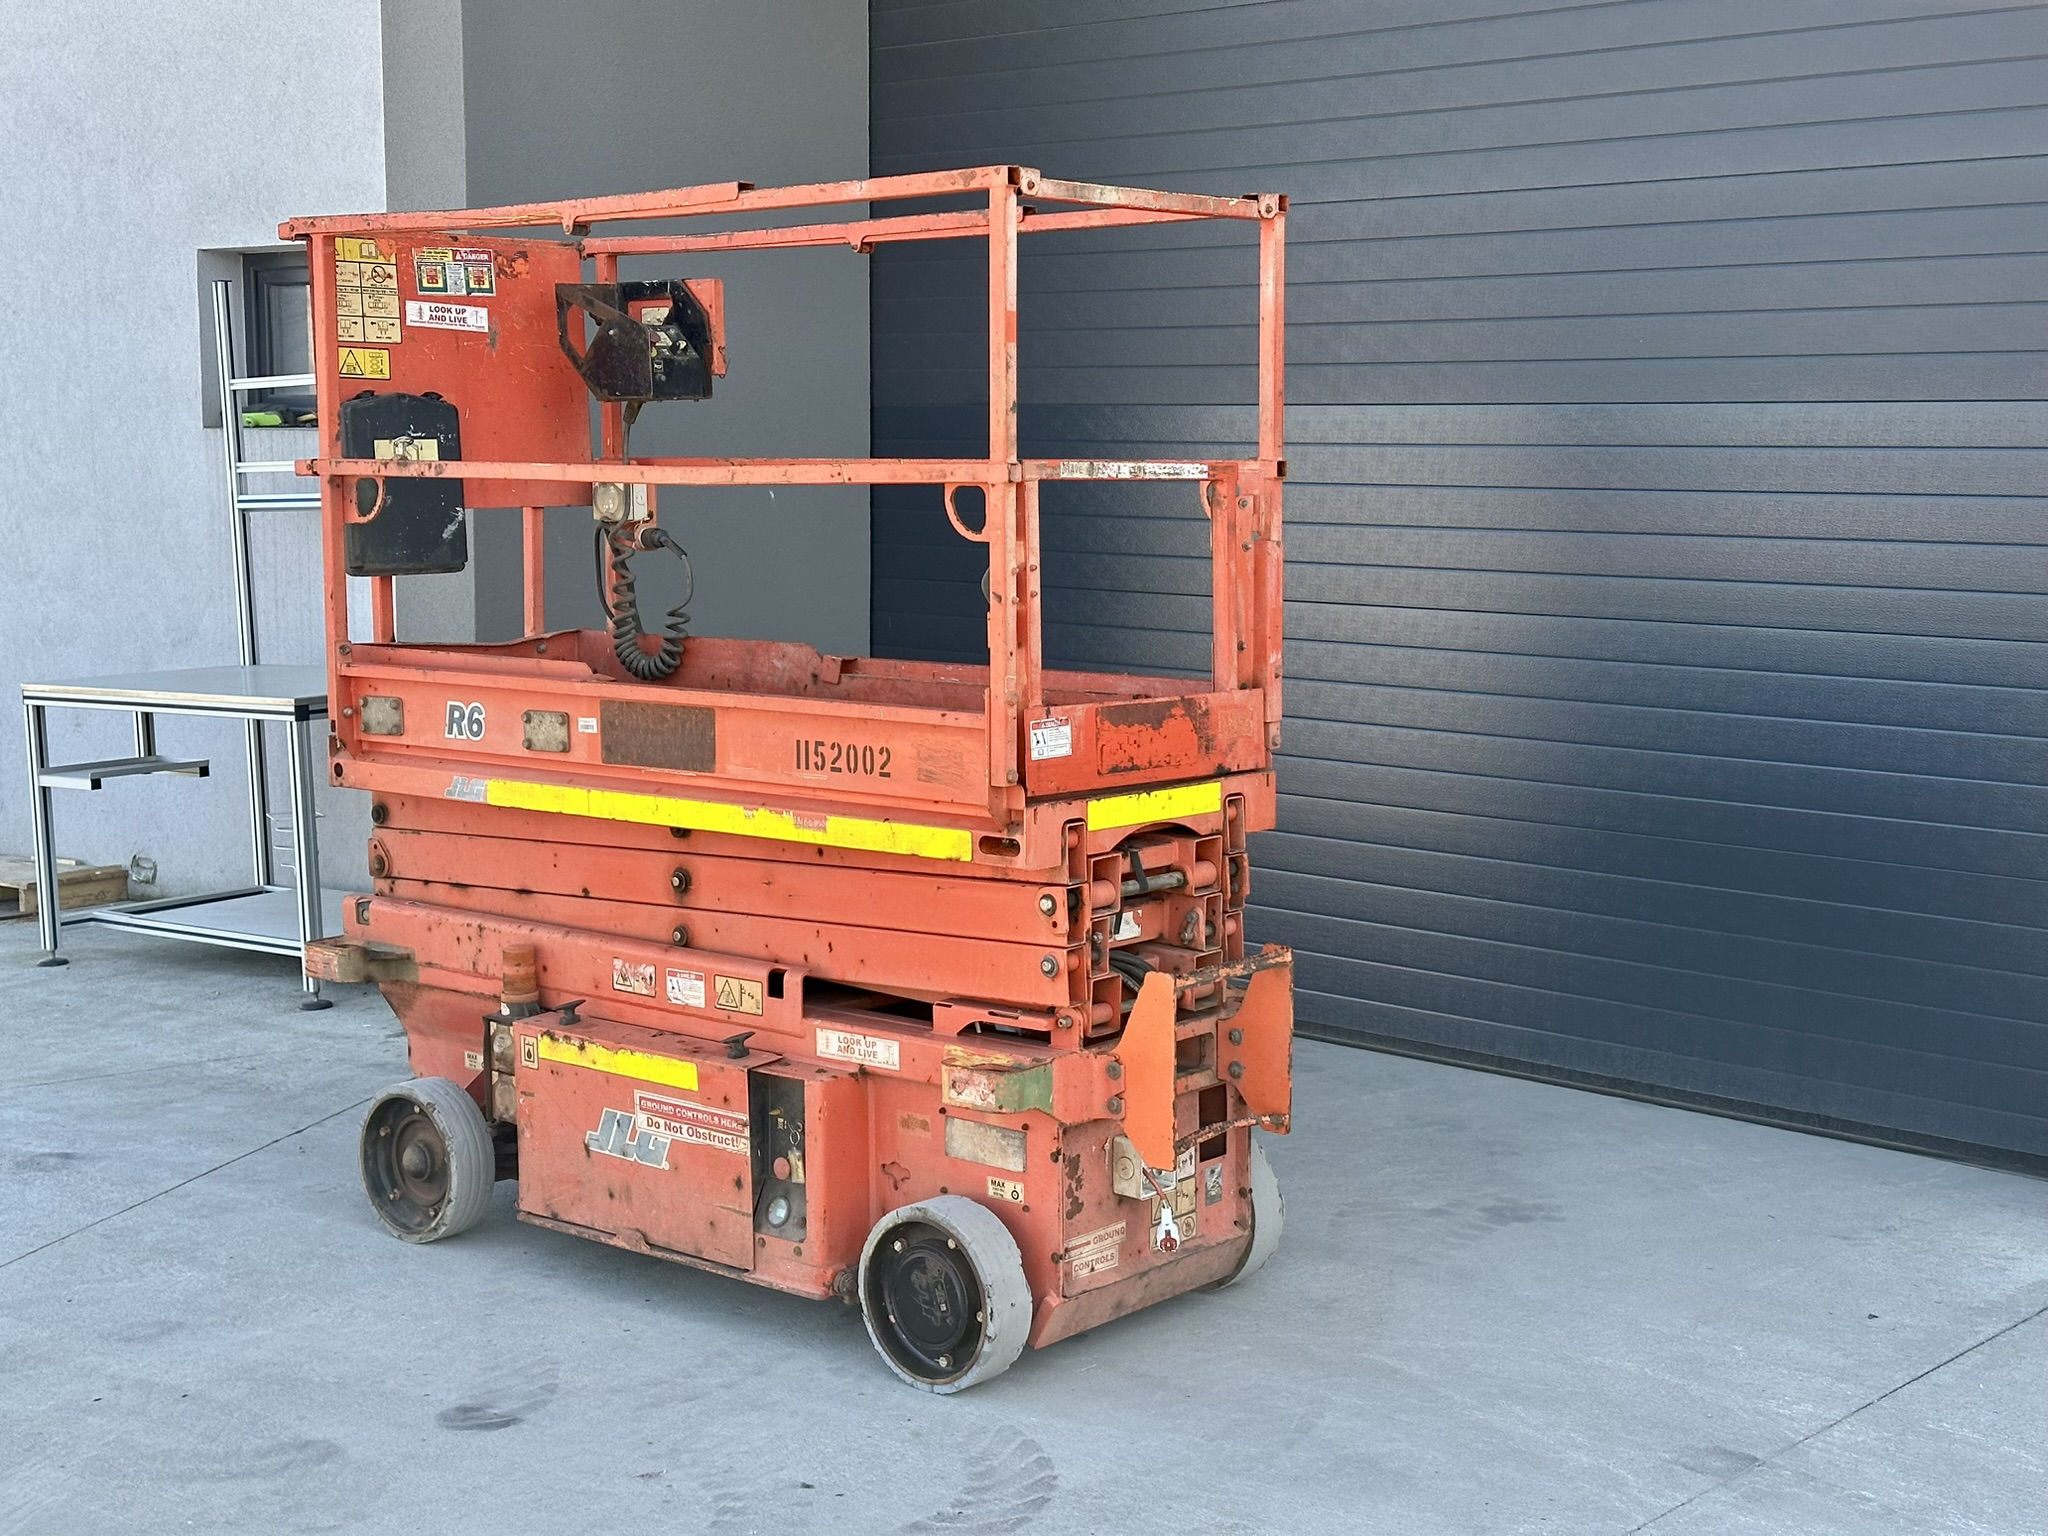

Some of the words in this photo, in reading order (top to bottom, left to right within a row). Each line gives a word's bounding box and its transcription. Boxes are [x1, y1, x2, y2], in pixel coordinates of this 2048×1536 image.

[463, 251, 489, 260] DANGER
[428, 305, 452, 315] LOOK
[454, 307, 467, 316] UP
[428, 313, 447, 322] AND
[448, 315, 468, 324] LIVE
[445, 701, 486, 740] R6
[796, 739, 892, 778] 1152002
[445, 775, 488, 803] JLG
[837, 1035, 862, 1047] LOOK
[864, 1040, 877, 1050] UP
[837, 1044, 856, 1055] AND
[858, 1048, 878, 1059] LIVE
[640, 1100, 675, 1115] GROUND
[675, 1108, 719, 1125] CONTROLS
[720, 1117, 743, 1130] HERE
[585, 1107, 672, 1169] JLG
[646, 1117, 661, 1129] Do
[664, 1121, 684, 1135] Not
[686, 1126, 740, 1148] Obstruct!
[990, 1179, 1006, 1189] MAX
[1092, 1226, 1125, 1245] GROUND
[1073, 1252, 1115, 1273] CONTROLS
